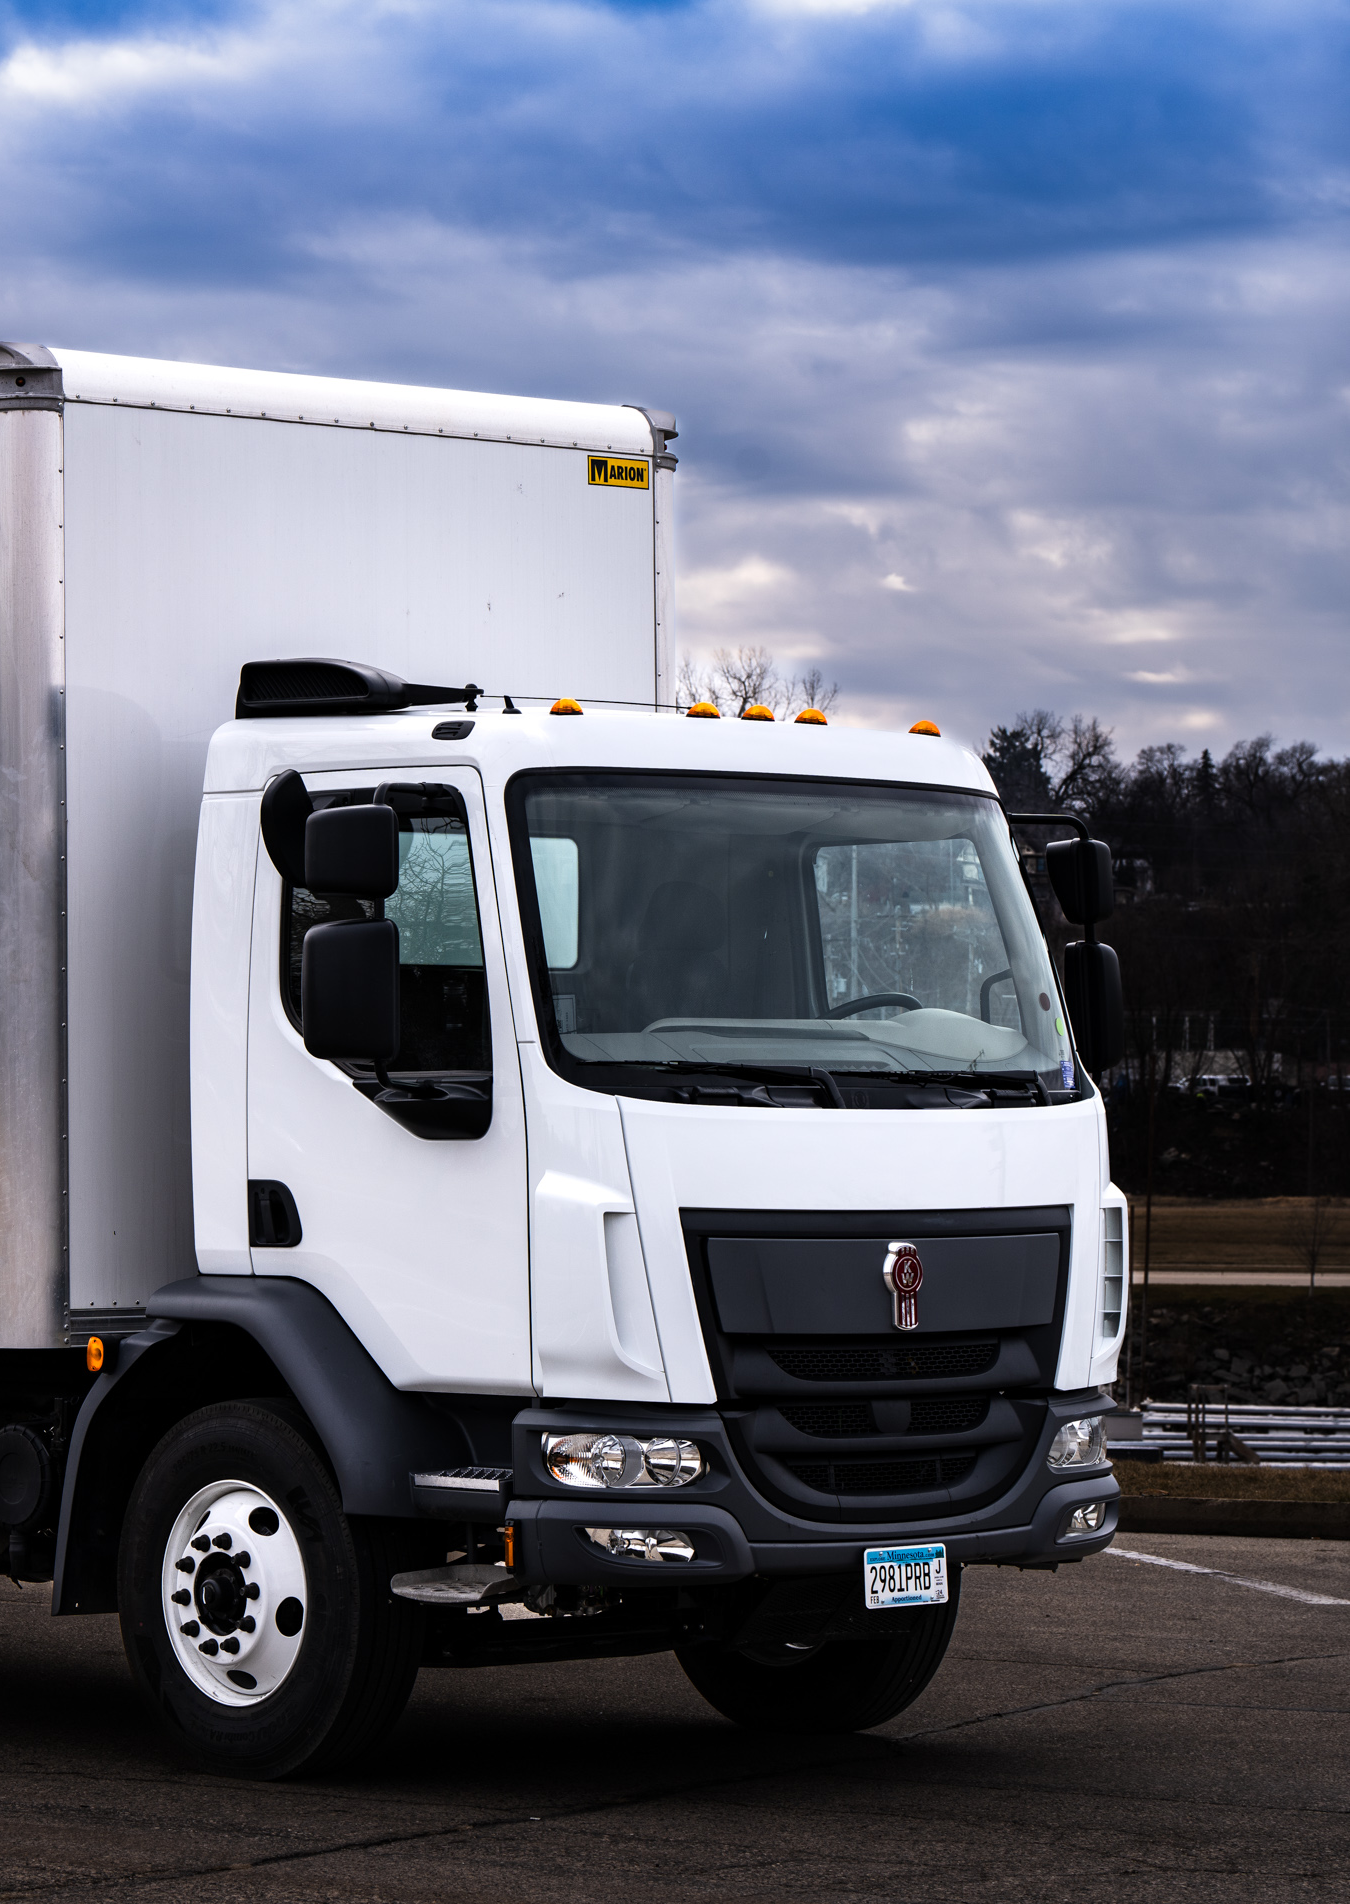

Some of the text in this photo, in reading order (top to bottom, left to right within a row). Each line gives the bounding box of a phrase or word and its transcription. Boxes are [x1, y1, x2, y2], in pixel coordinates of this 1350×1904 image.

[590, 459, 644, 483] MARION
[935, 1560, 941, 1574] J
[870, 1562, 931, 1594] 2981PRB
[871, 1596, 879, 1604] FEB
[892, 1595, 922, 1603] Apportioned
